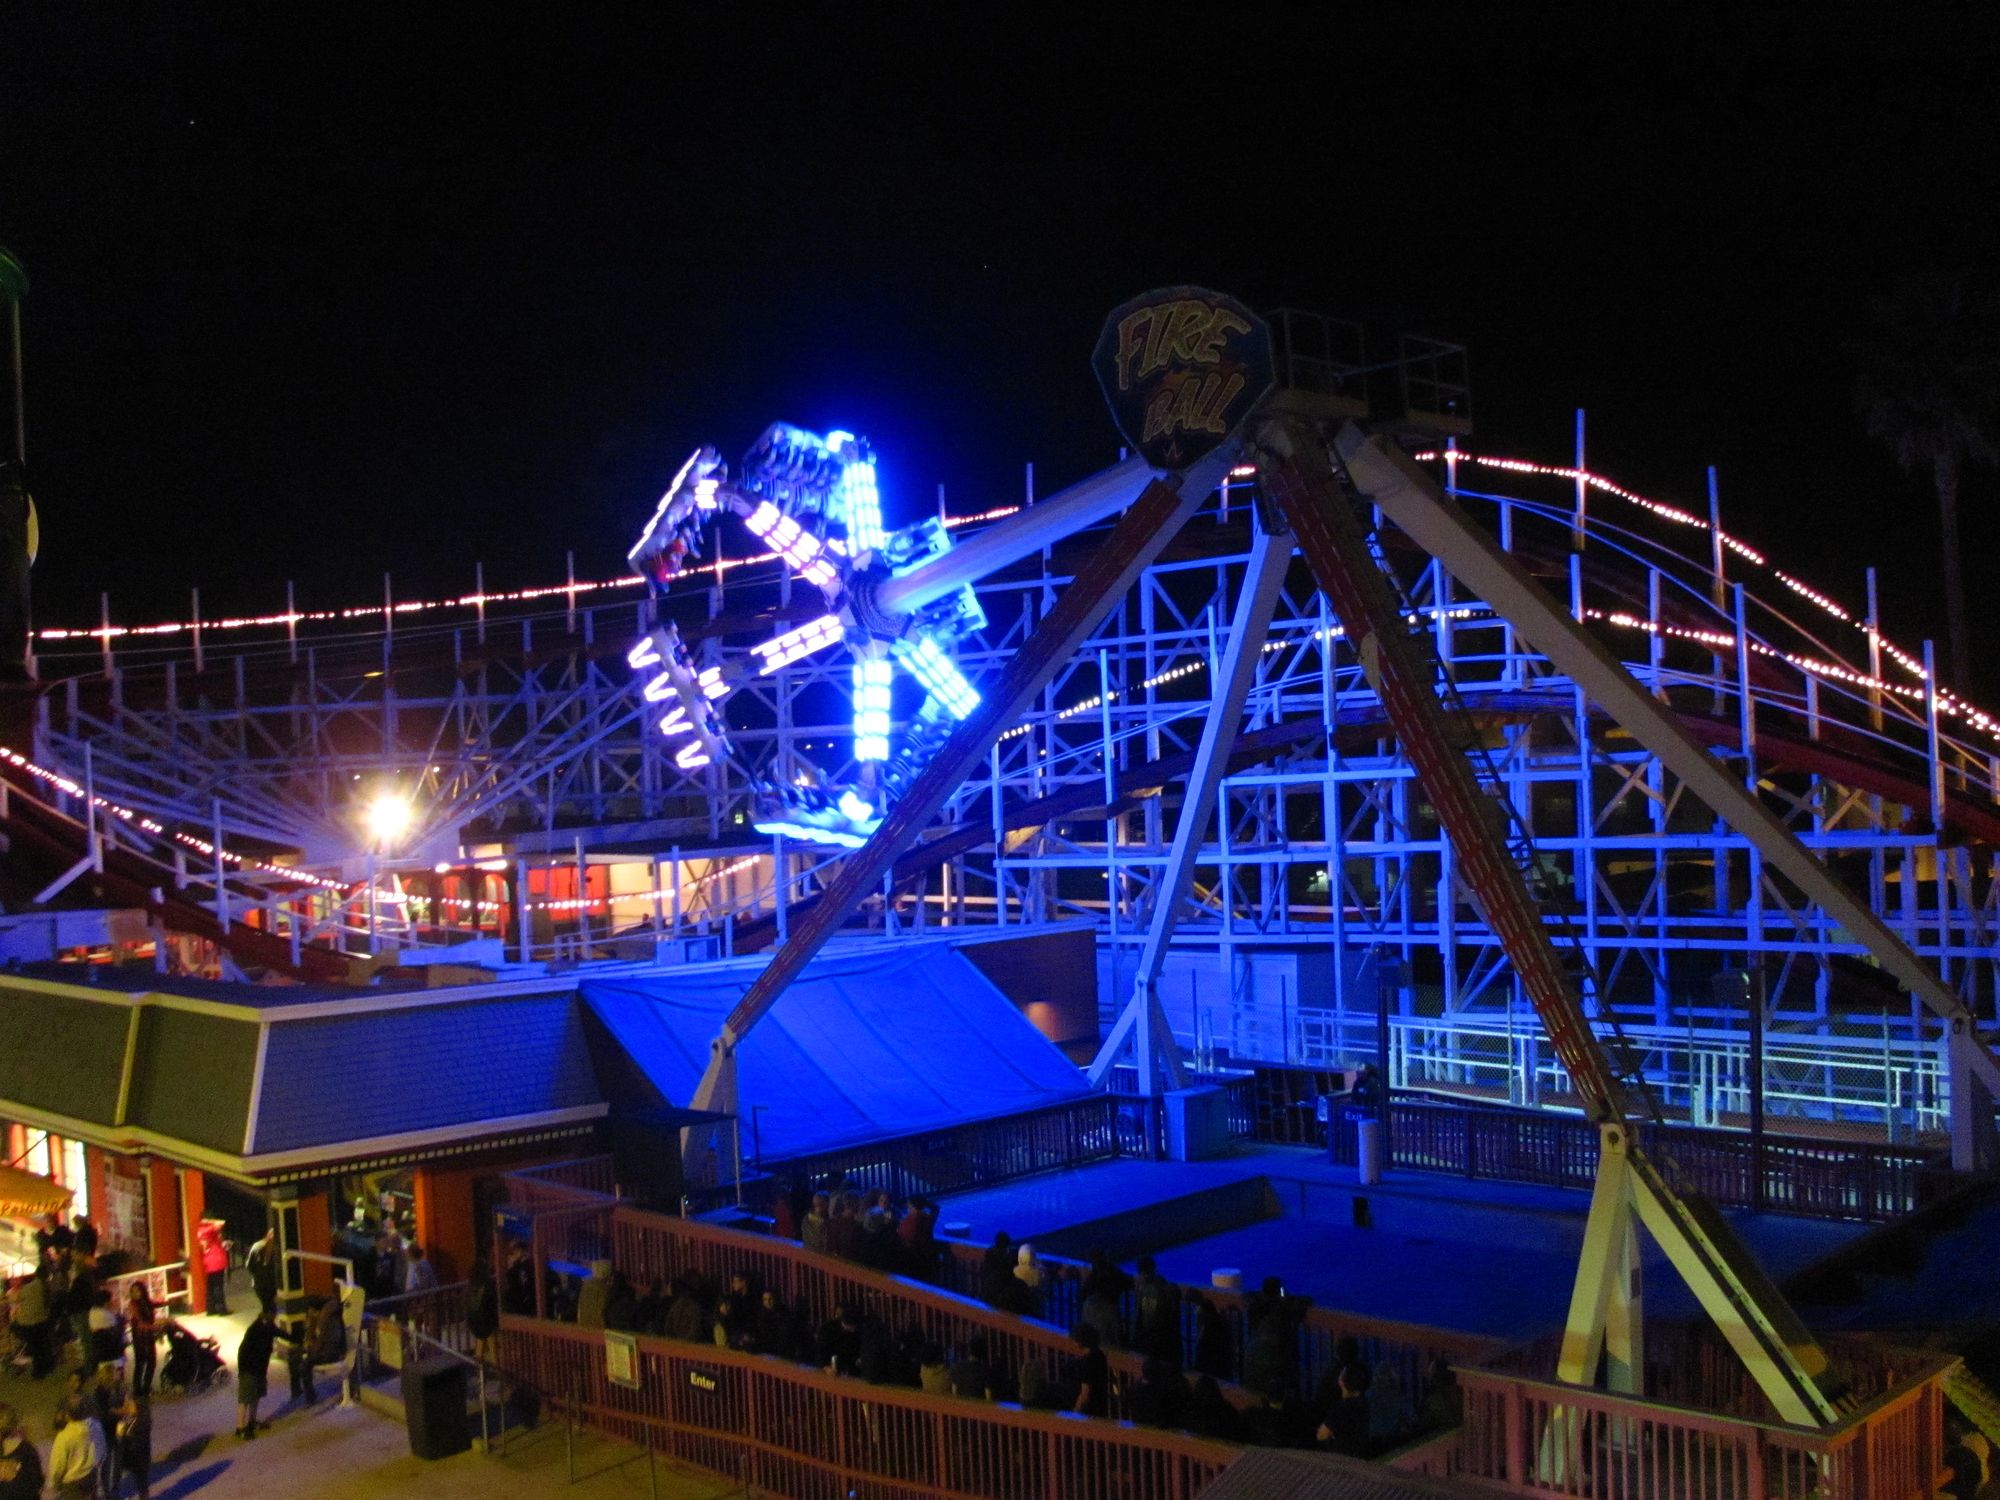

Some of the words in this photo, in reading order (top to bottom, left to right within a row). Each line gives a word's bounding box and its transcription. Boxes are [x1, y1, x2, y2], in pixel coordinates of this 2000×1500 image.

[1114, 300, 1252, 391] FIRE
[1142, 371, 1246, 443] BALL
[1344, 1111, 1363, 1121] Exit
[690, 1371, 716, 1391] Enter
